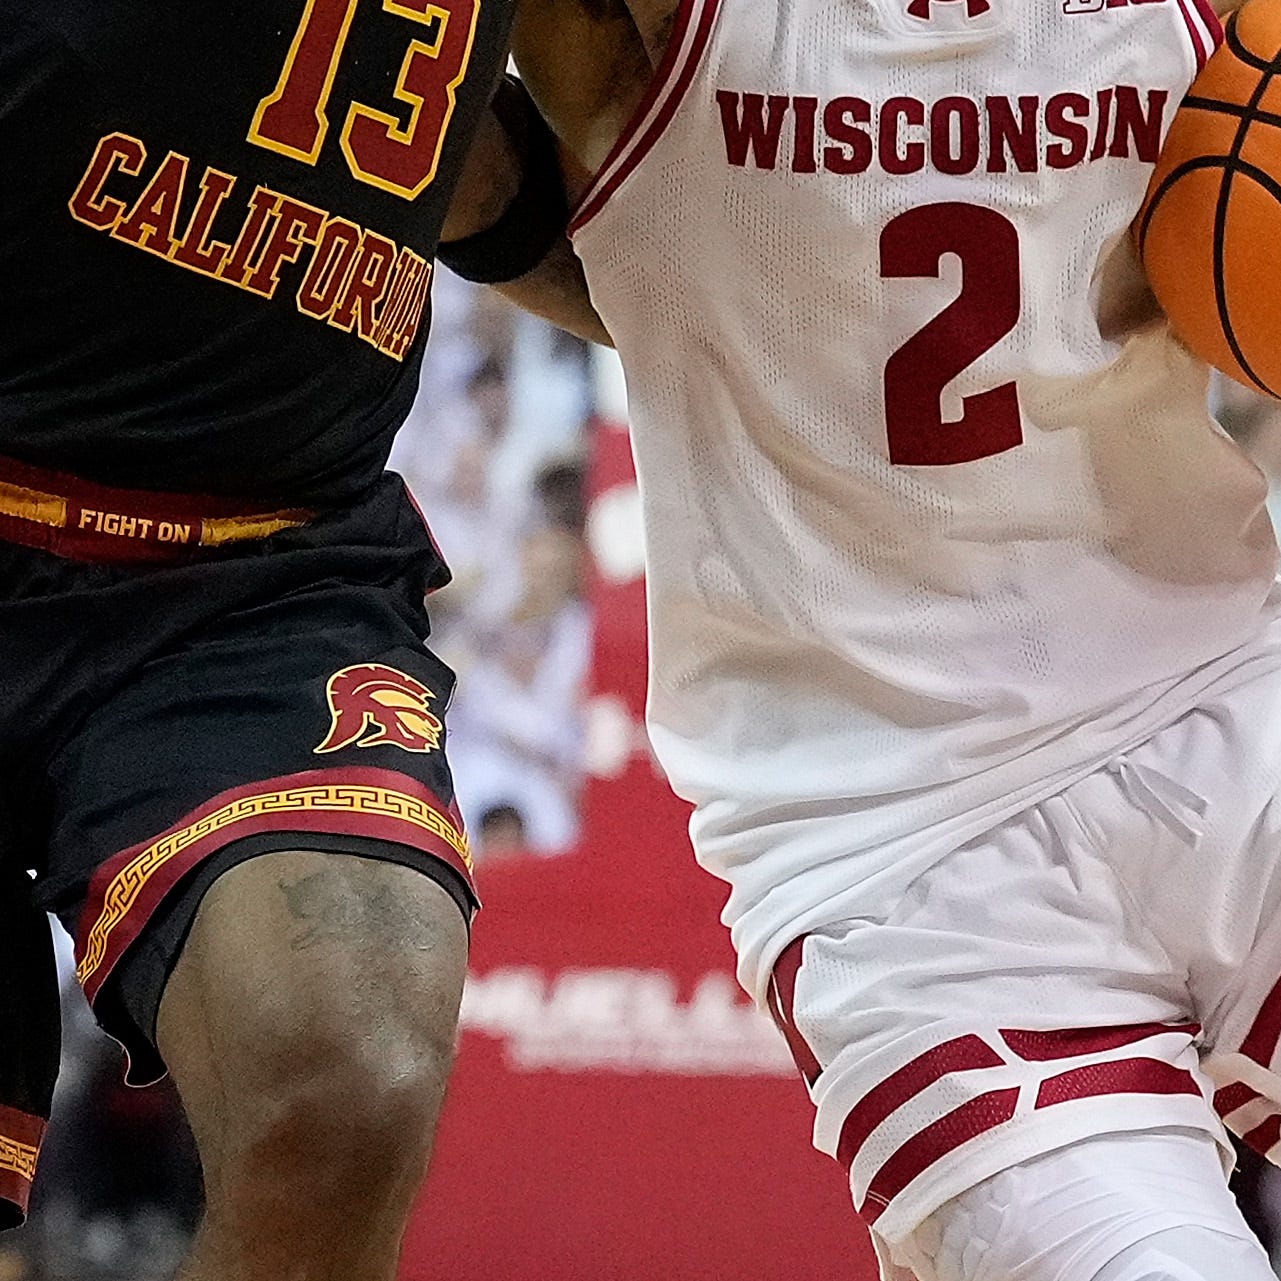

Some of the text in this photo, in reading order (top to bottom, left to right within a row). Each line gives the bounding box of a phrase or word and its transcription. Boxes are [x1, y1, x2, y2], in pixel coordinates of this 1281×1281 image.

[716, 84, 1169, 176] WISCONSIN
[879, 201, 1024, 466] 2
[78, 508, 191, 544] FIGHT ON
